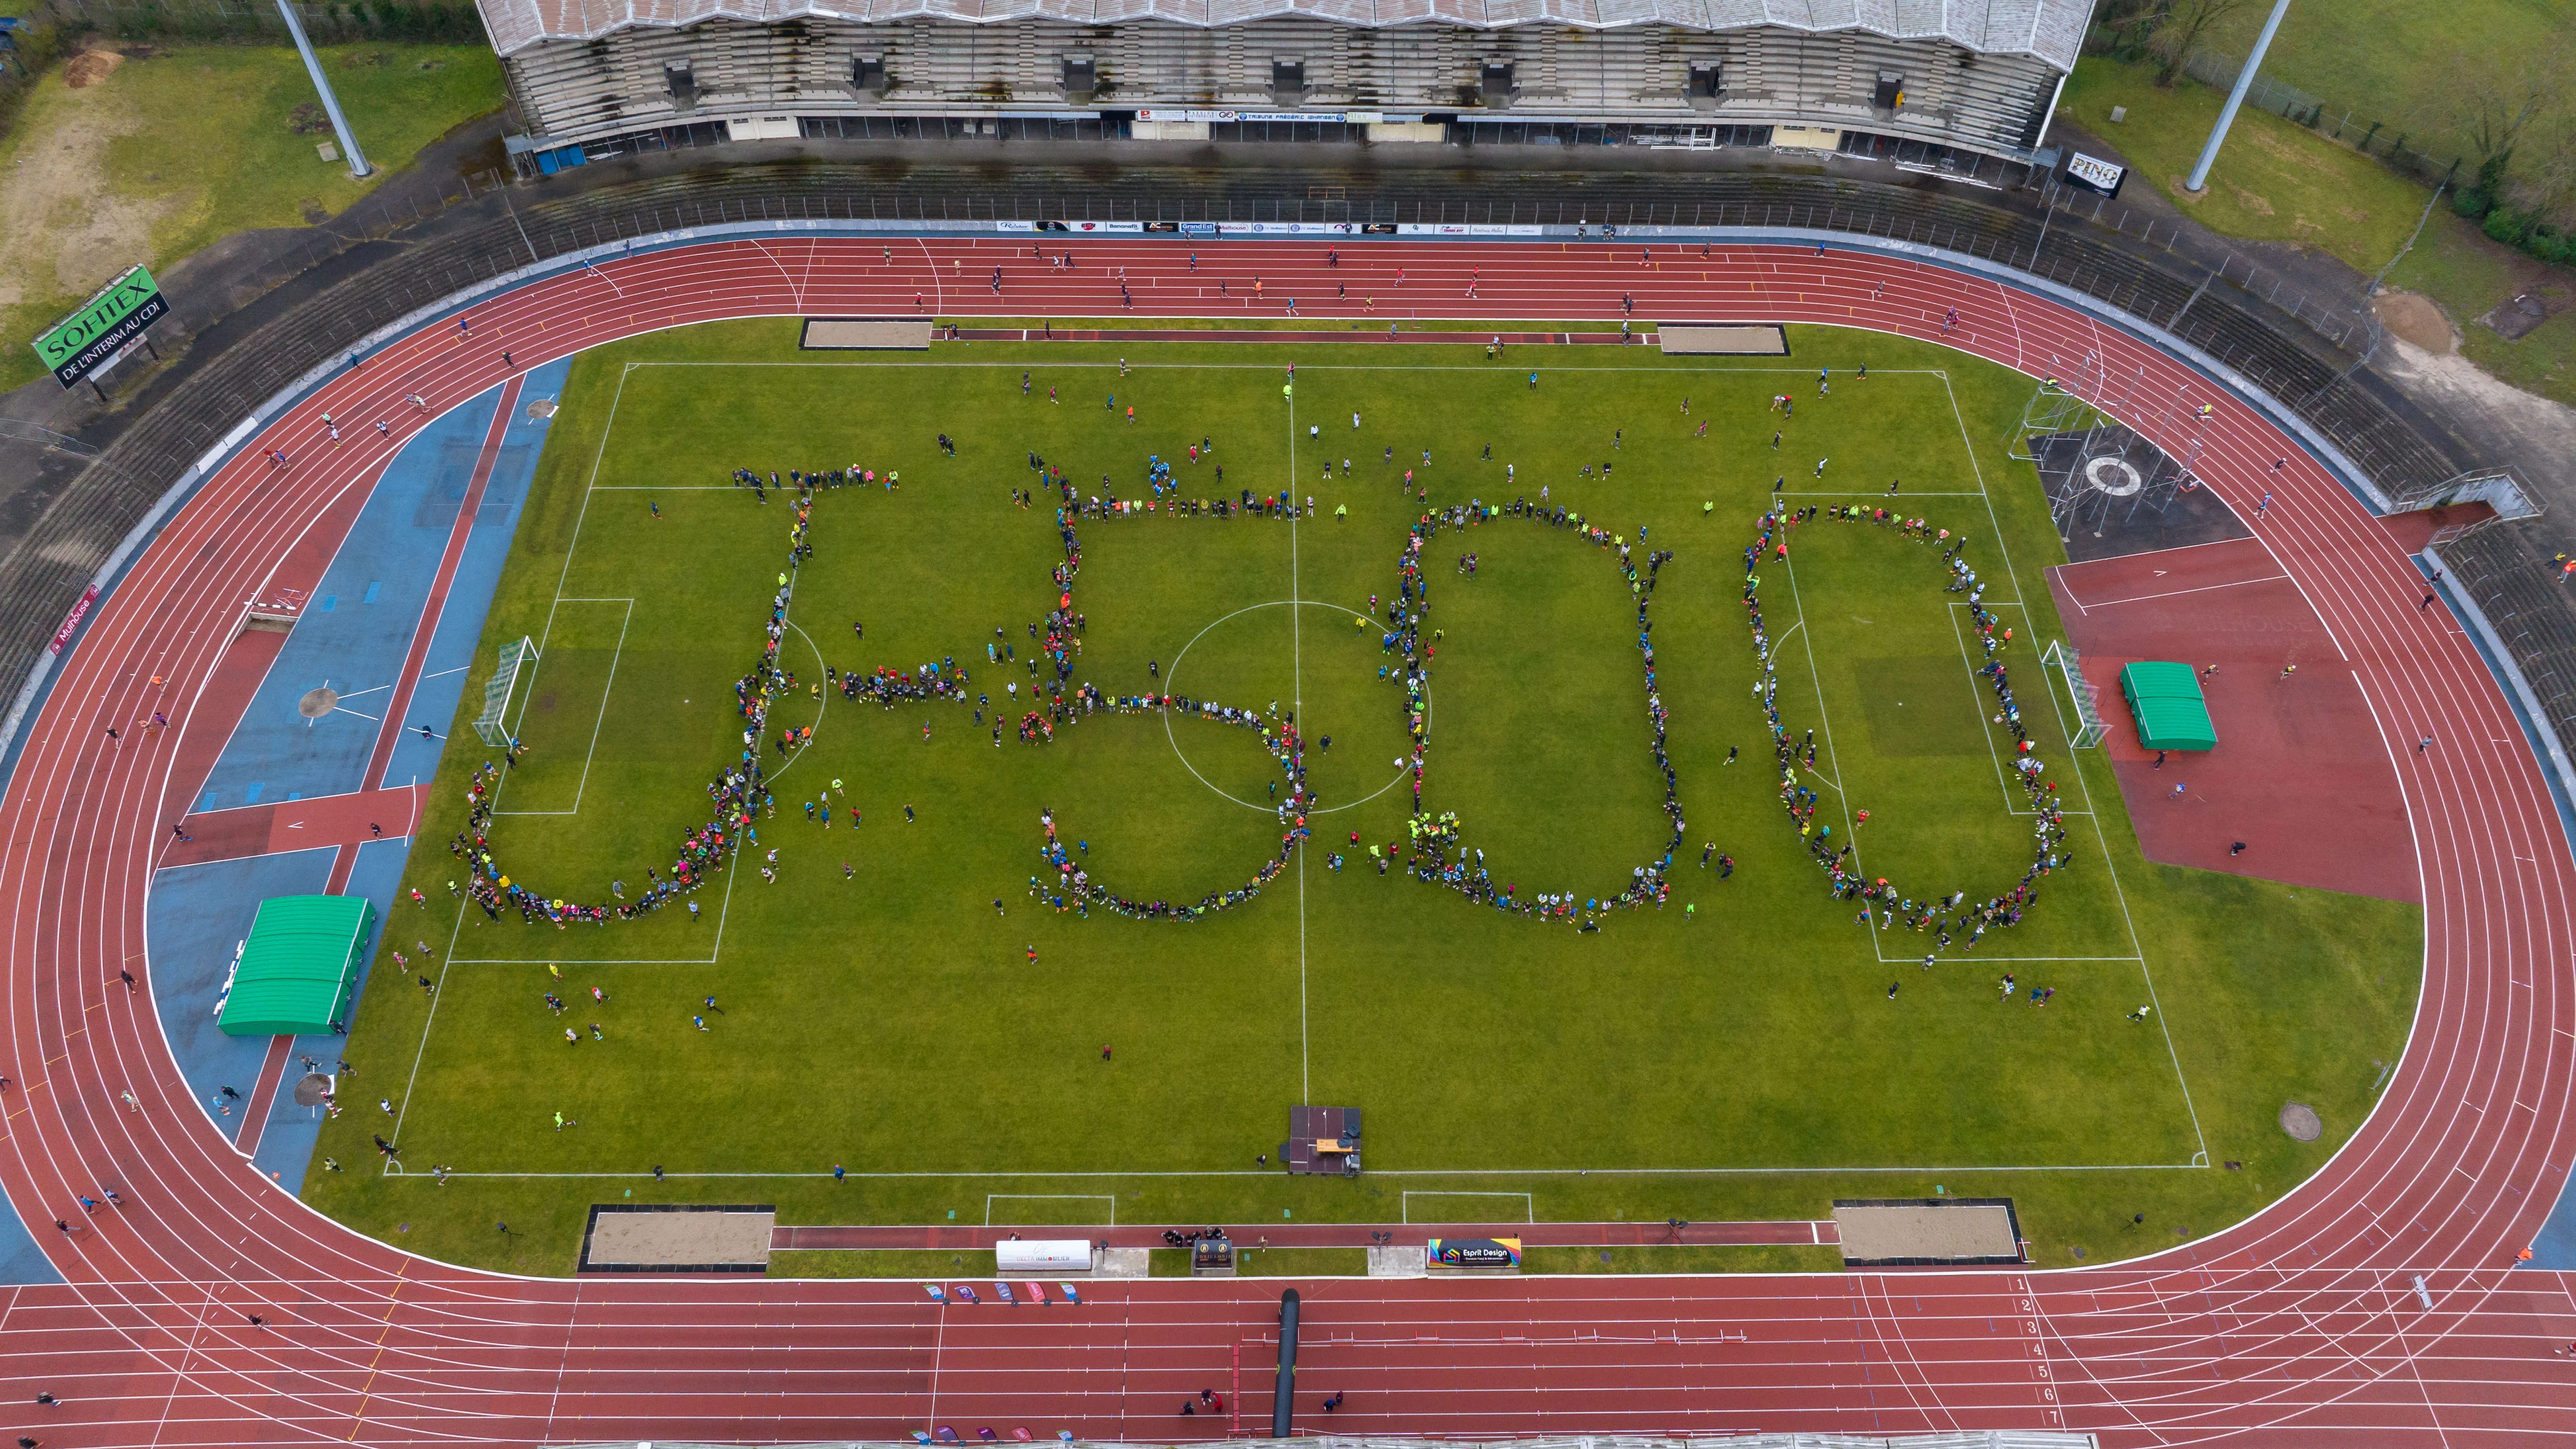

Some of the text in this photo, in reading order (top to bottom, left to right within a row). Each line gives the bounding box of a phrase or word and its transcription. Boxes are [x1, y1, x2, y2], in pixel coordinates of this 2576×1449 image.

[2071, 157, 2118, 181] PINO
[47, 277, 150, 360] SOFITEX
[62, 301, 160, 380] DE L'INTERIM AU CDI
[59, 600, 90, 642] Mulhouse
[2017, 1278, 2025, 1290] 1
[2021, 1299, 2031, 1312] 2
[2027, 1321, 2036, 1334] 3
[2034, 1343, 2043, 1355] 4
[2038, 1365, 2048, 1378] 5
[2044, 1388, 2054, 1401] 6
[2049, 1411, 2057, 1424] 7
